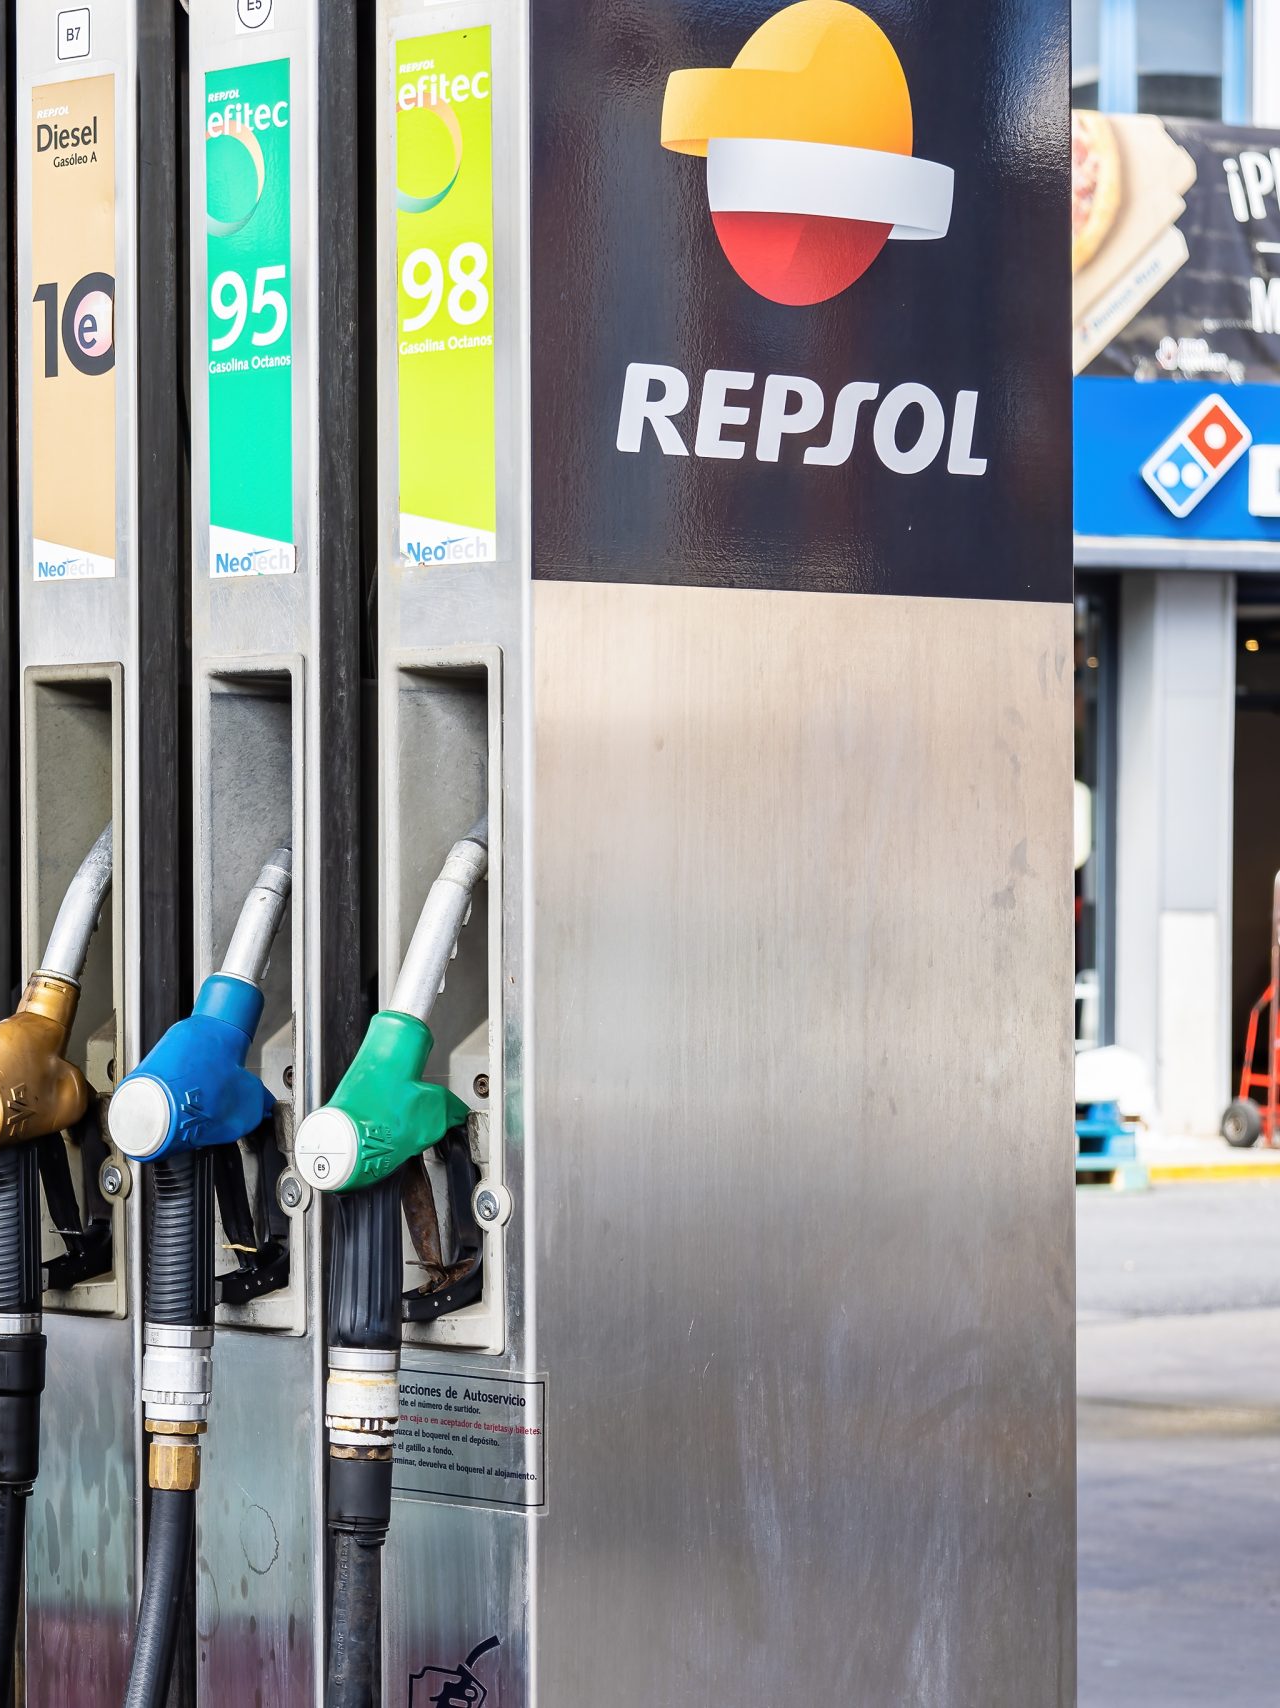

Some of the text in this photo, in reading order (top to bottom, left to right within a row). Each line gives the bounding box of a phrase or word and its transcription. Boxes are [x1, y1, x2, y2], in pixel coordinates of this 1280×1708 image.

[66, 27, 81, 42] B7
[399, 59, 435, 74] REPSOL
[207, 88, 240, 103] REPSOL
[398, 71, 489, 112] efitec
[36, 105, 70, 119] REPSOL
[207, 100, 289, 138] efitec
[37, 115, 97, 152] Diesel
[53, 151, 98, 168] Gasóleo A
[402, 241, 489, 333] 98
[210, 264, 288, 352] 95
[32, 271, 115, 378] 10
[399, 335, 492, 356] Gasolina Octanos
[208, 354, 291, 374] Gasolina Octanos
[616, 362, 988, 476] REPSOL
[445, 1385, 458, 1399] de
[463, 1388, 526, 1407] Autoservicio
[410, 1399, 416, 1407] el
[417, 1400, 443, 1411] número
[444, 1402, 452, 1411] de
[454, 1404, 481, 1415] surtidor.
[409, 1414, 423, 1424] caja
[440, 1419, 472, 1429] aceptador
[473, 1421, 482, 1430] de
[515, 1425, 542, 1436] billetes.
[414, 1428, 421, 1437] el
[422, 1429, 450, 1441] boquerel
[461, 1434, 468, 1443] el
[469, 1435, 500, 1447] depósito.
[398, 1442, 404, 1450] el
[405, 1443, 426, 1453] gatillo
[433, 1445, 454, 1456] fondo.
[418, 1458, 447, 1470] devuelva
[448, 1463, 455, 1471] el
[456, 1462, 485, 1475] boquerel
[486, 1467, 493, 1476] al
[494, 1468, 537, 1481] alojamiento.
